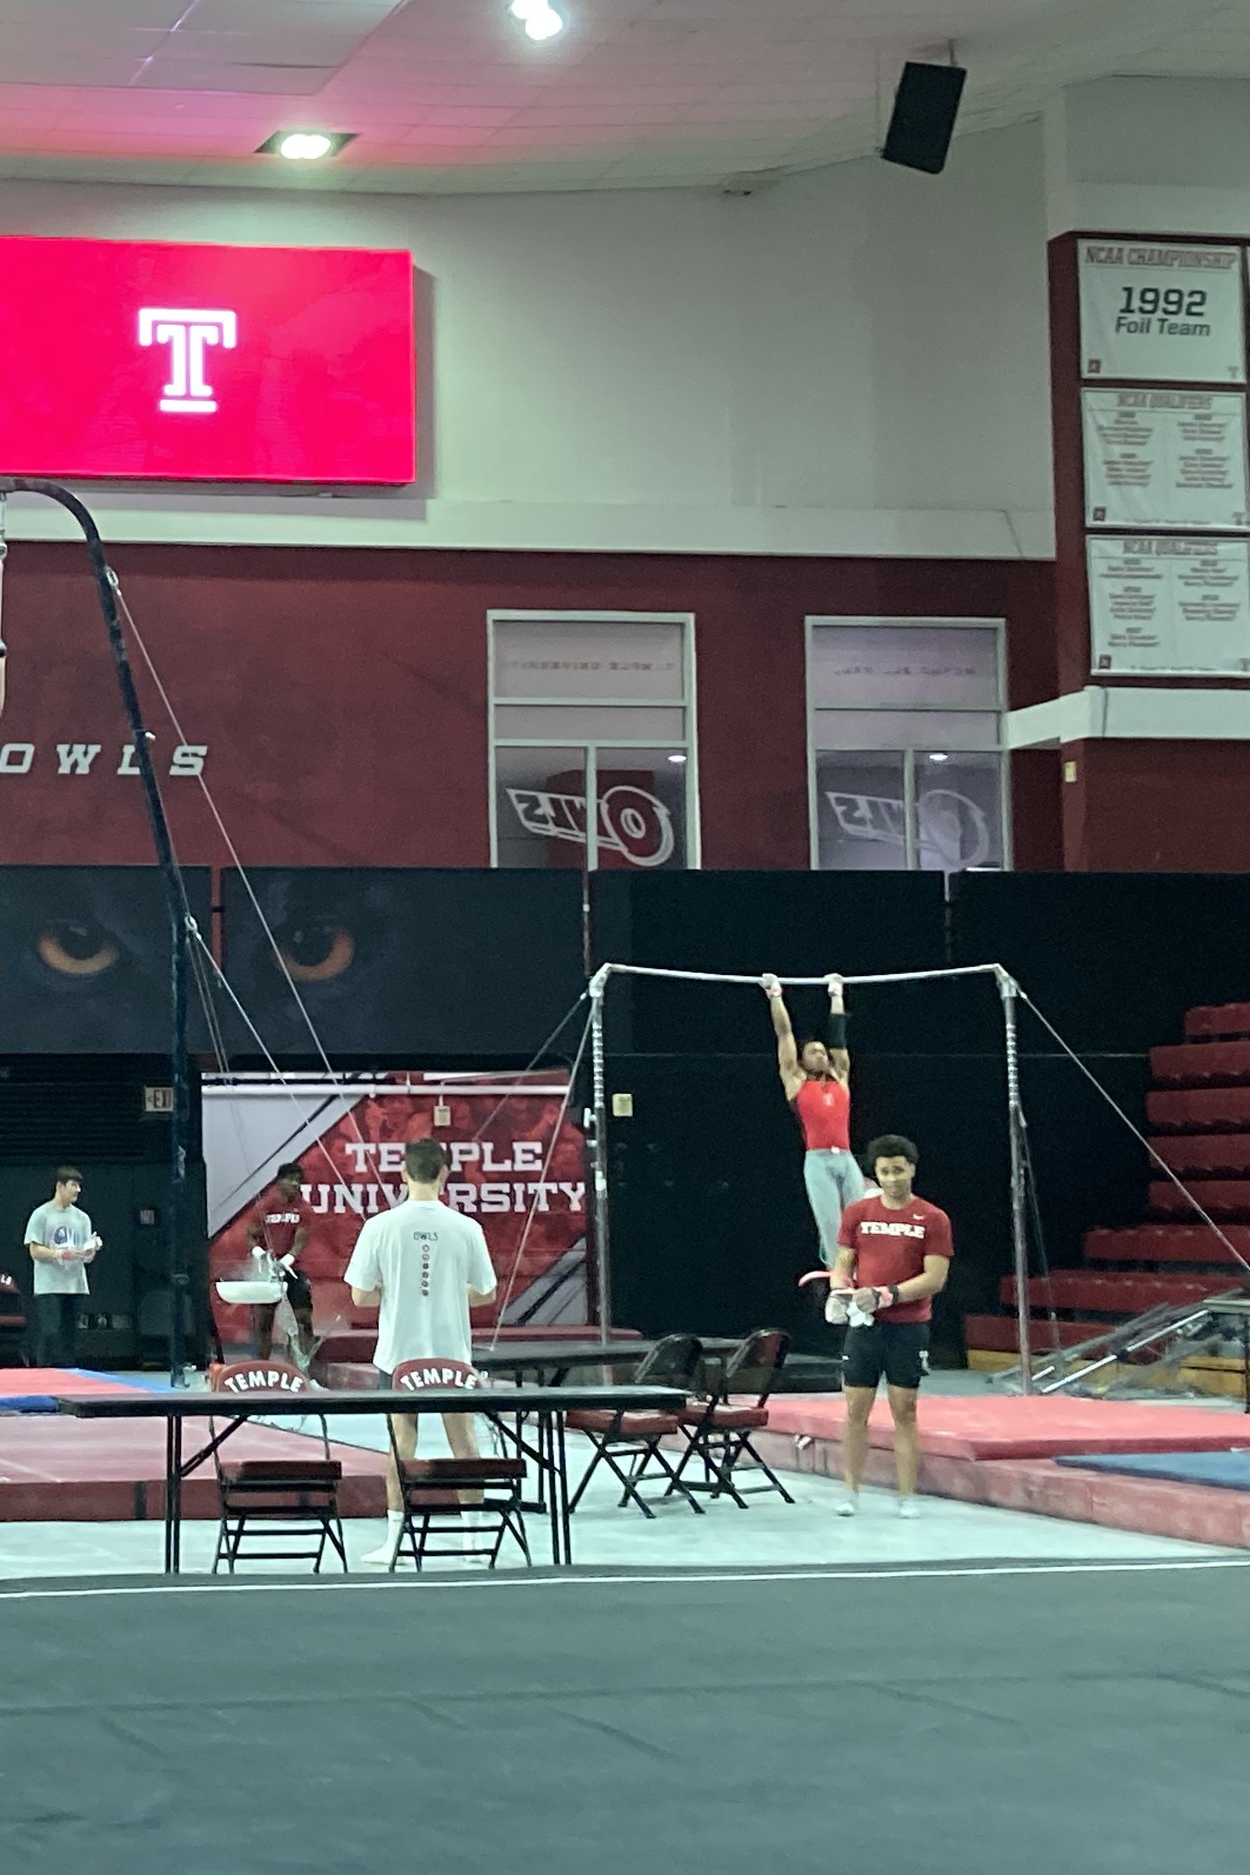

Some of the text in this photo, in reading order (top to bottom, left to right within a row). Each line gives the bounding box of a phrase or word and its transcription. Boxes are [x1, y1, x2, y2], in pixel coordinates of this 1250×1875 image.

[1119, 286, 1207, 317] 1992
[1115, 316, 1211, 337] Foil Team
[139, 307, 237, 413] T
[345, 1142, 543, 1173] TEPLE
[300, 1182, 585, 1214] UNIVRSITY
[860, 1221, 926, 1239] TEMPLE
[224, 1369, 303, 1394] TEMPLE
[400, 1367, 478, 1391] TEMPLE
